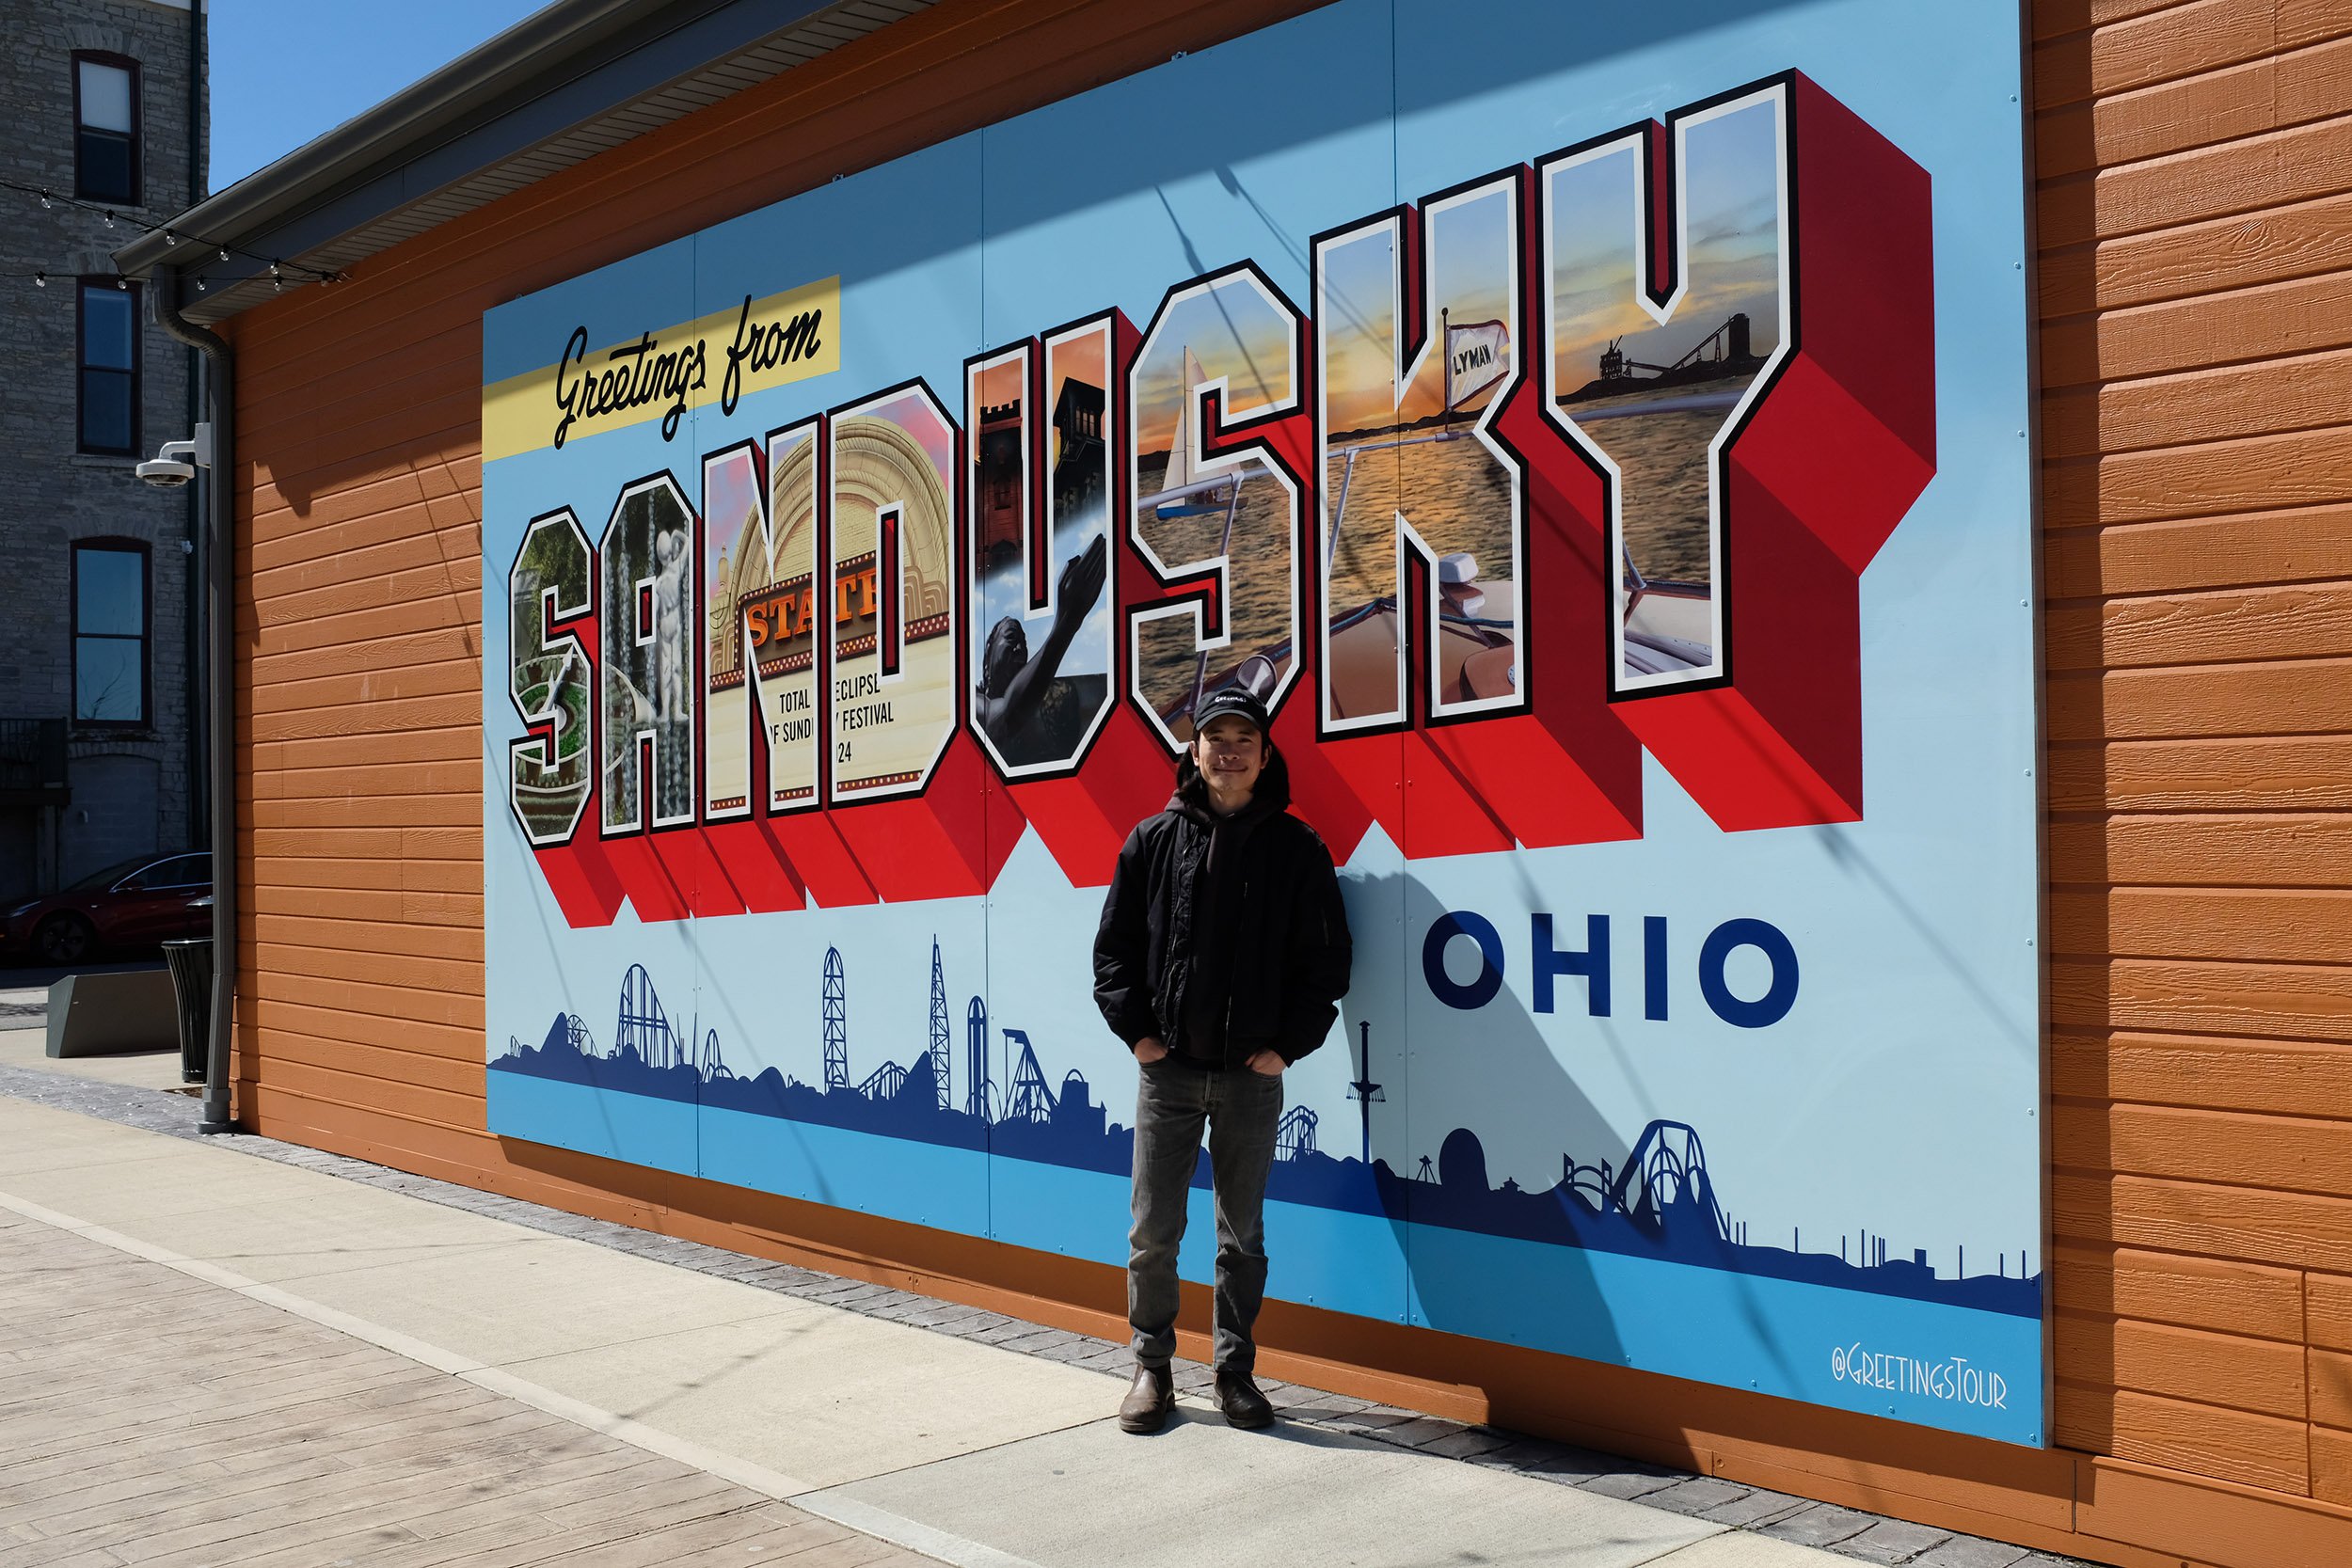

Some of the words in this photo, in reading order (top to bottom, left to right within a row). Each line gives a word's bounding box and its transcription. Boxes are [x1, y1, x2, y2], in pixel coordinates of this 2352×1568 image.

[554, 325, 707, 450] Greetings
[721, 294, 822, 417] from
[1453, 343, 1491, 375] LYMAN
[508, 68, 1797, 849] SANDUSKY
[780, 689, 810, 714] TOTAL
[843, 702, 894, 731] FESTIVAL
[836, 741, 851, 763] 24
[1422, 911, 1799, 1028] OHIO
